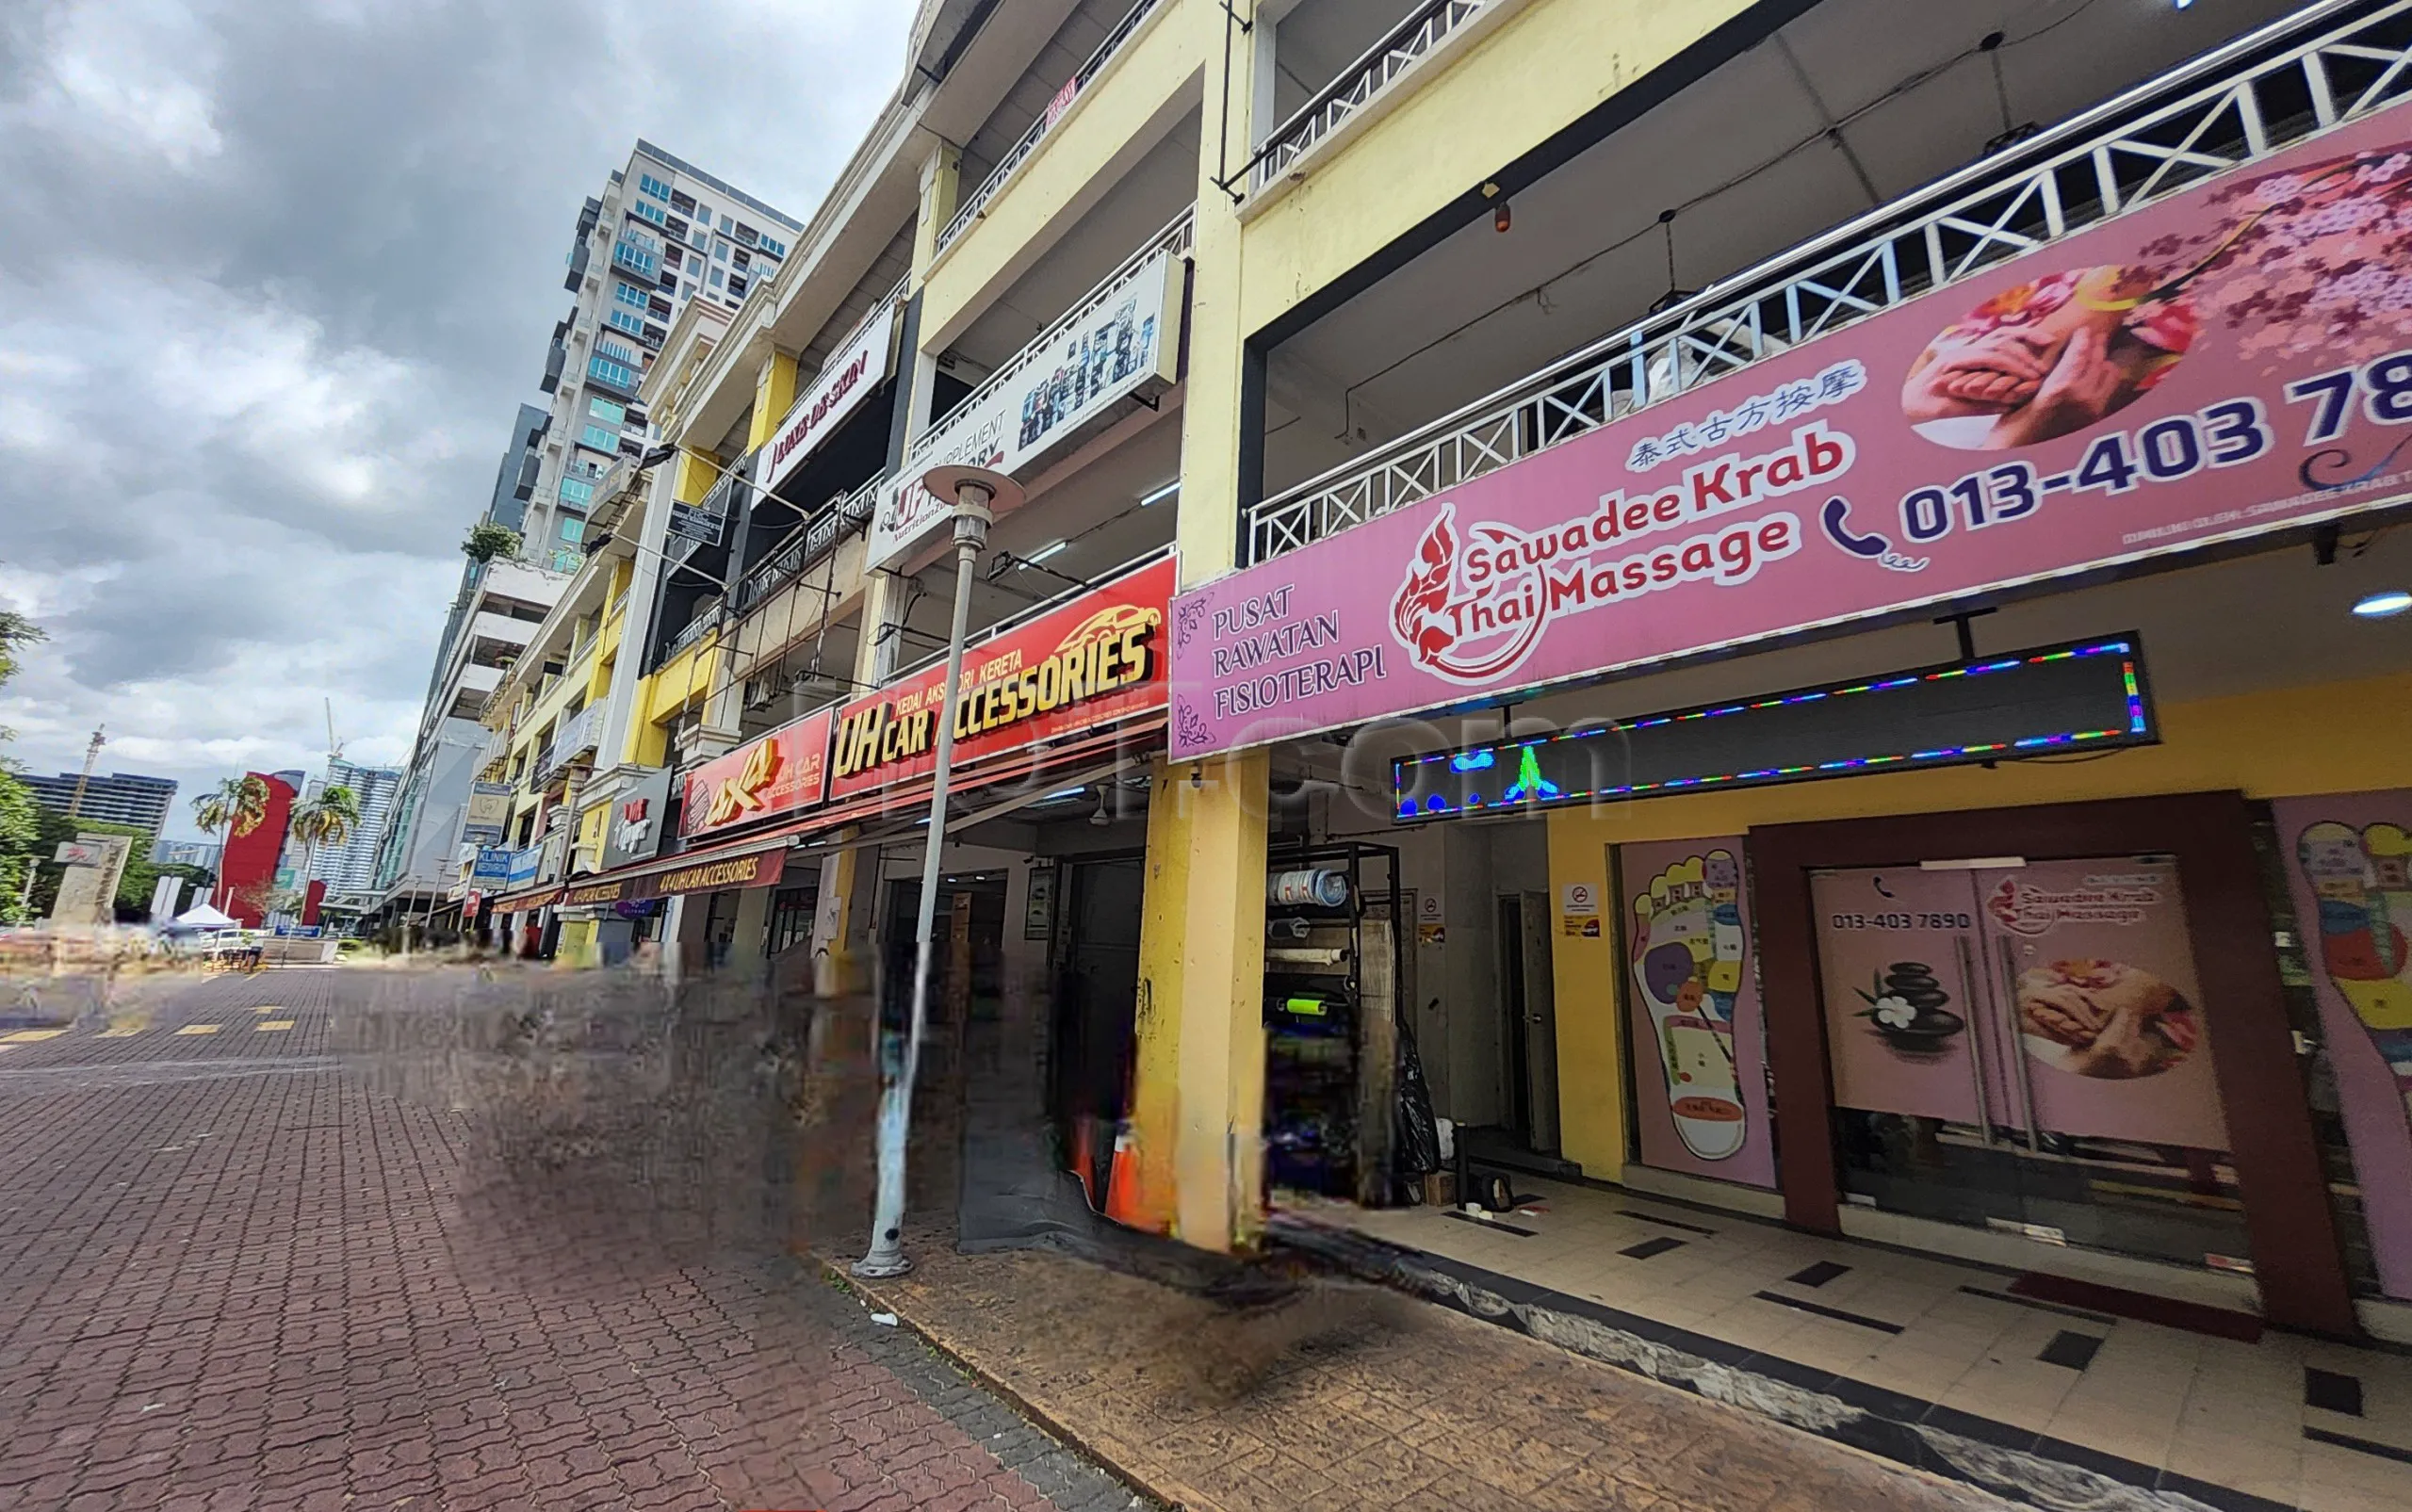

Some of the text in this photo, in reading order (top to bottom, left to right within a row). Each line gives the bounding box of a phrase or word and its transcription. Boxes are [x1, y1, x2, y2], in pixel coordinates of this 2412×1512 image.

[1630, 364, 1860, 467] 泰式古方按摩
[1904, 402, 2266, 541] 013-403
[1467, 431, 1844, 583] Sawadee Krab
[1214, 584, 1295, 636] PUSAT
[1447, 520, 1790, 640] Thai Massage
[1214, 610, 1339, 678] RAWATAN
[834, 702, 887, 777] UH
[882, 709, 929, 762] CAR
[934, 623, 1156, 746] CCESSORIES
[896, 693, 921, 716] KEDAI
[979, 649, 1023, 686] KERETA
[1214, 644, 1388, 721] FISIOTERAPI
[794, 752, 821, 774] CAR
[478, 852, 509, 862] KLINIK
[700, 856, 759, 886] ACCESSORIES
[1832, 913, 1913, 930] 013-403
